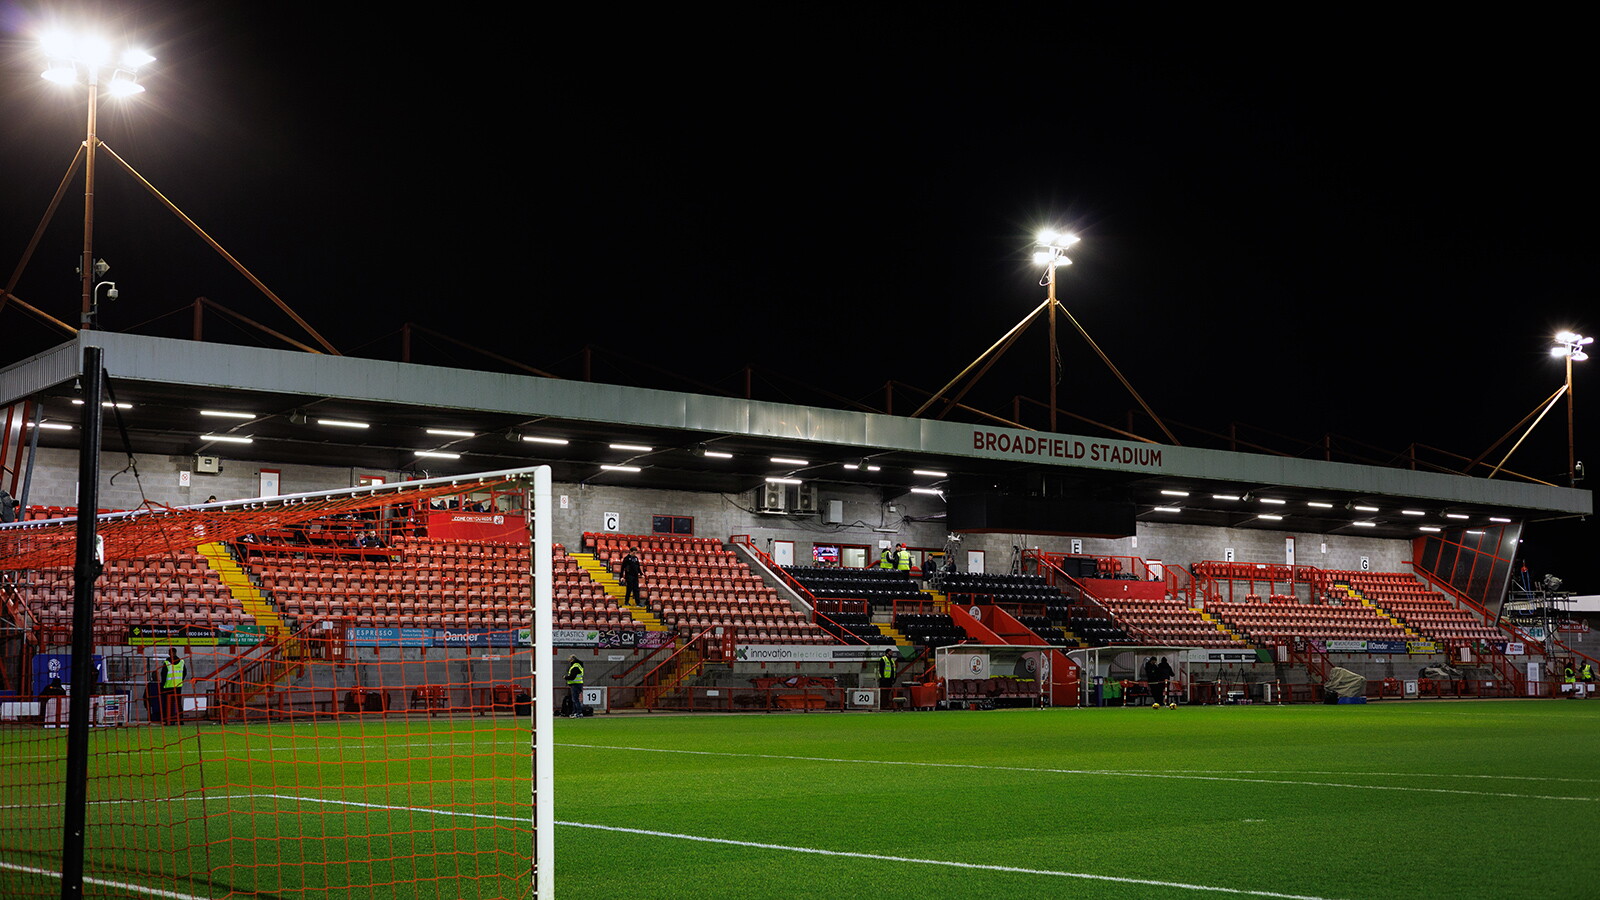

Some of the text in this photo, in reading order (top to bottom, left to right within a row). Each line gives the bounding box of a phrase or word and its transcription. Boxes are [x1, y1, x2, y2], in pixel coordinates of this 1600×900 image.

[973, 431, 1162, 467] BROADFIELD STADIUM
[607, 517, 616, 530] C
[1074, 543, 1079, 554] E
[1227, 551, 1232, 561] F
[1361, 559, 1368, 569] G
[621, 633, 634, 642] CM
[751, 648, 830, 658] innovation electrical
[587, 693, 597, 702] 19
[859, 694, 870, 702] 20
